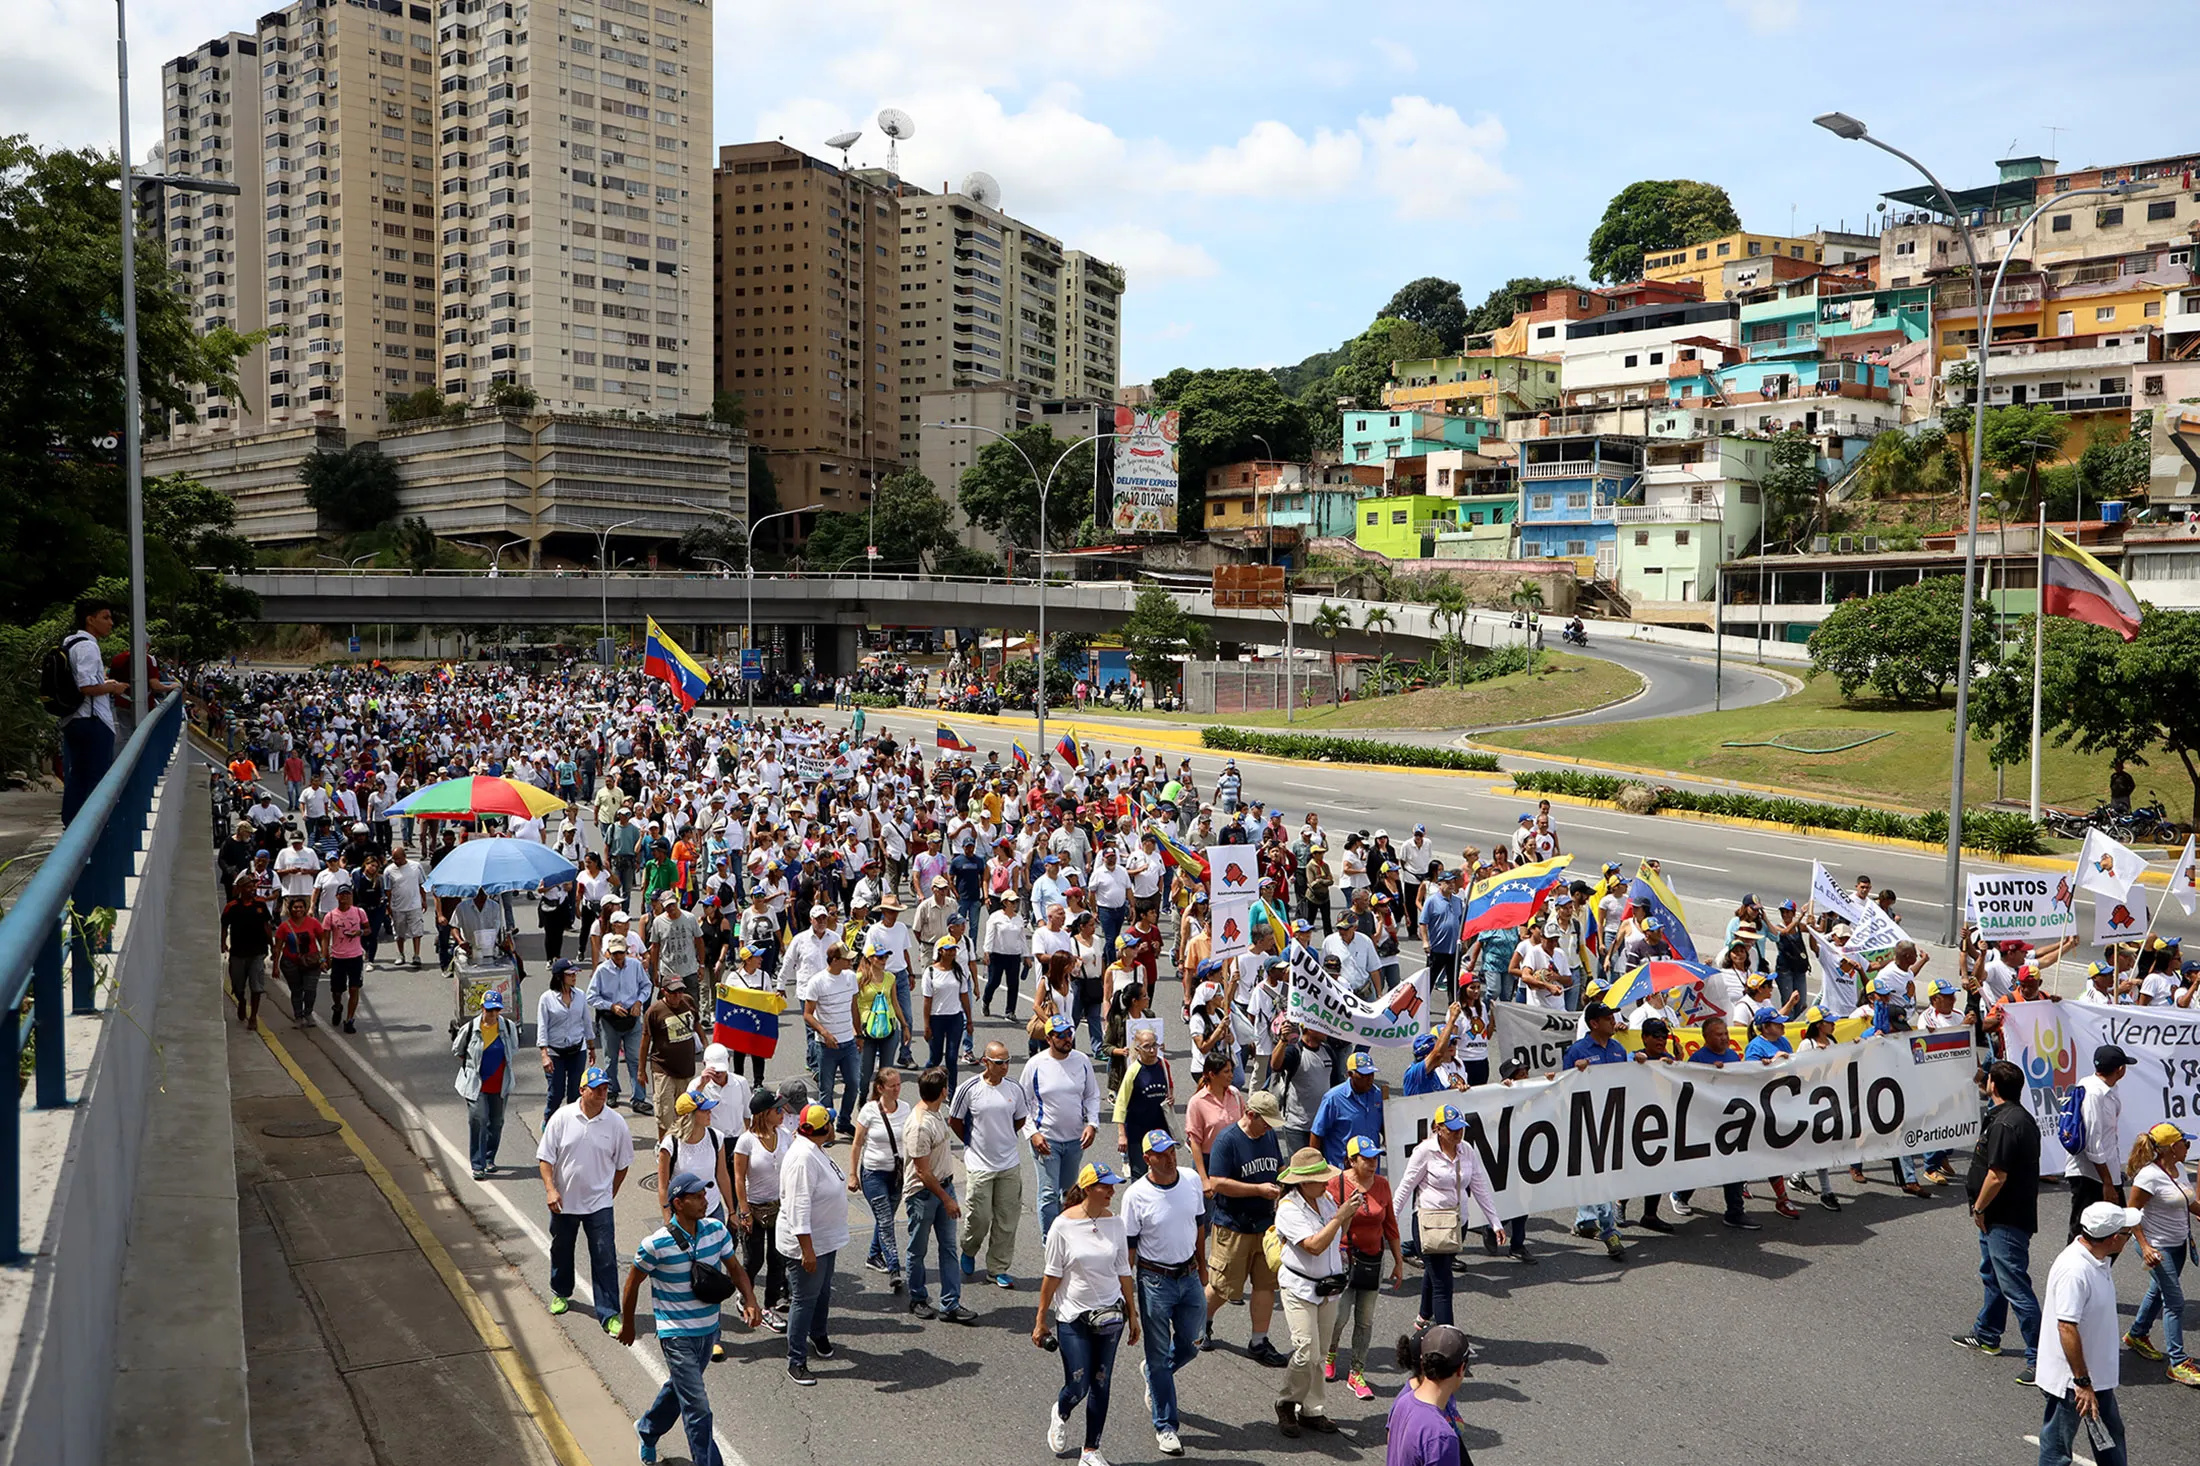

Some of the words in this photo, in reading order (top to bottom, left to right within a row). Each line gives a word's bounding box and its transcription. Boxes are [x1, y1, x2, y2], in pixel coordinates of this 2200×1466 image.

[1116, 476, 1148, 486] DELIVERY
[1149, 478, 1177, 488] EXPRESS
[1121, 491, 1139, 505] 0412
[1974, 880, 2047, 897] JUNTOS
[1978, 900, 2010, 912] POR
[2013, 900, 2033, 912] UN
[1980, 916, 2036, 928] SALARIO
[2041, 912, 2074, 927] DIGNO
[1290, 992, 1354, 1032] SARIO
[1360, 1021, 1420, 1039] DIGNO
[1324, 995, 1353, 1019] UN
[1513, 1039, 1573, 1069] DICT
[1925, 1053, 1933, 1061] UN
[1933, 1051, 1950, 1060] NUEVO
[1950, 1048, 1971, 1058] TIEMPO
[2159, 1058, 2175, 1089] y
[2163, 1087, 2186, 1119] la
[1904, 1121, 1978, 1148] @PartidoUNT
